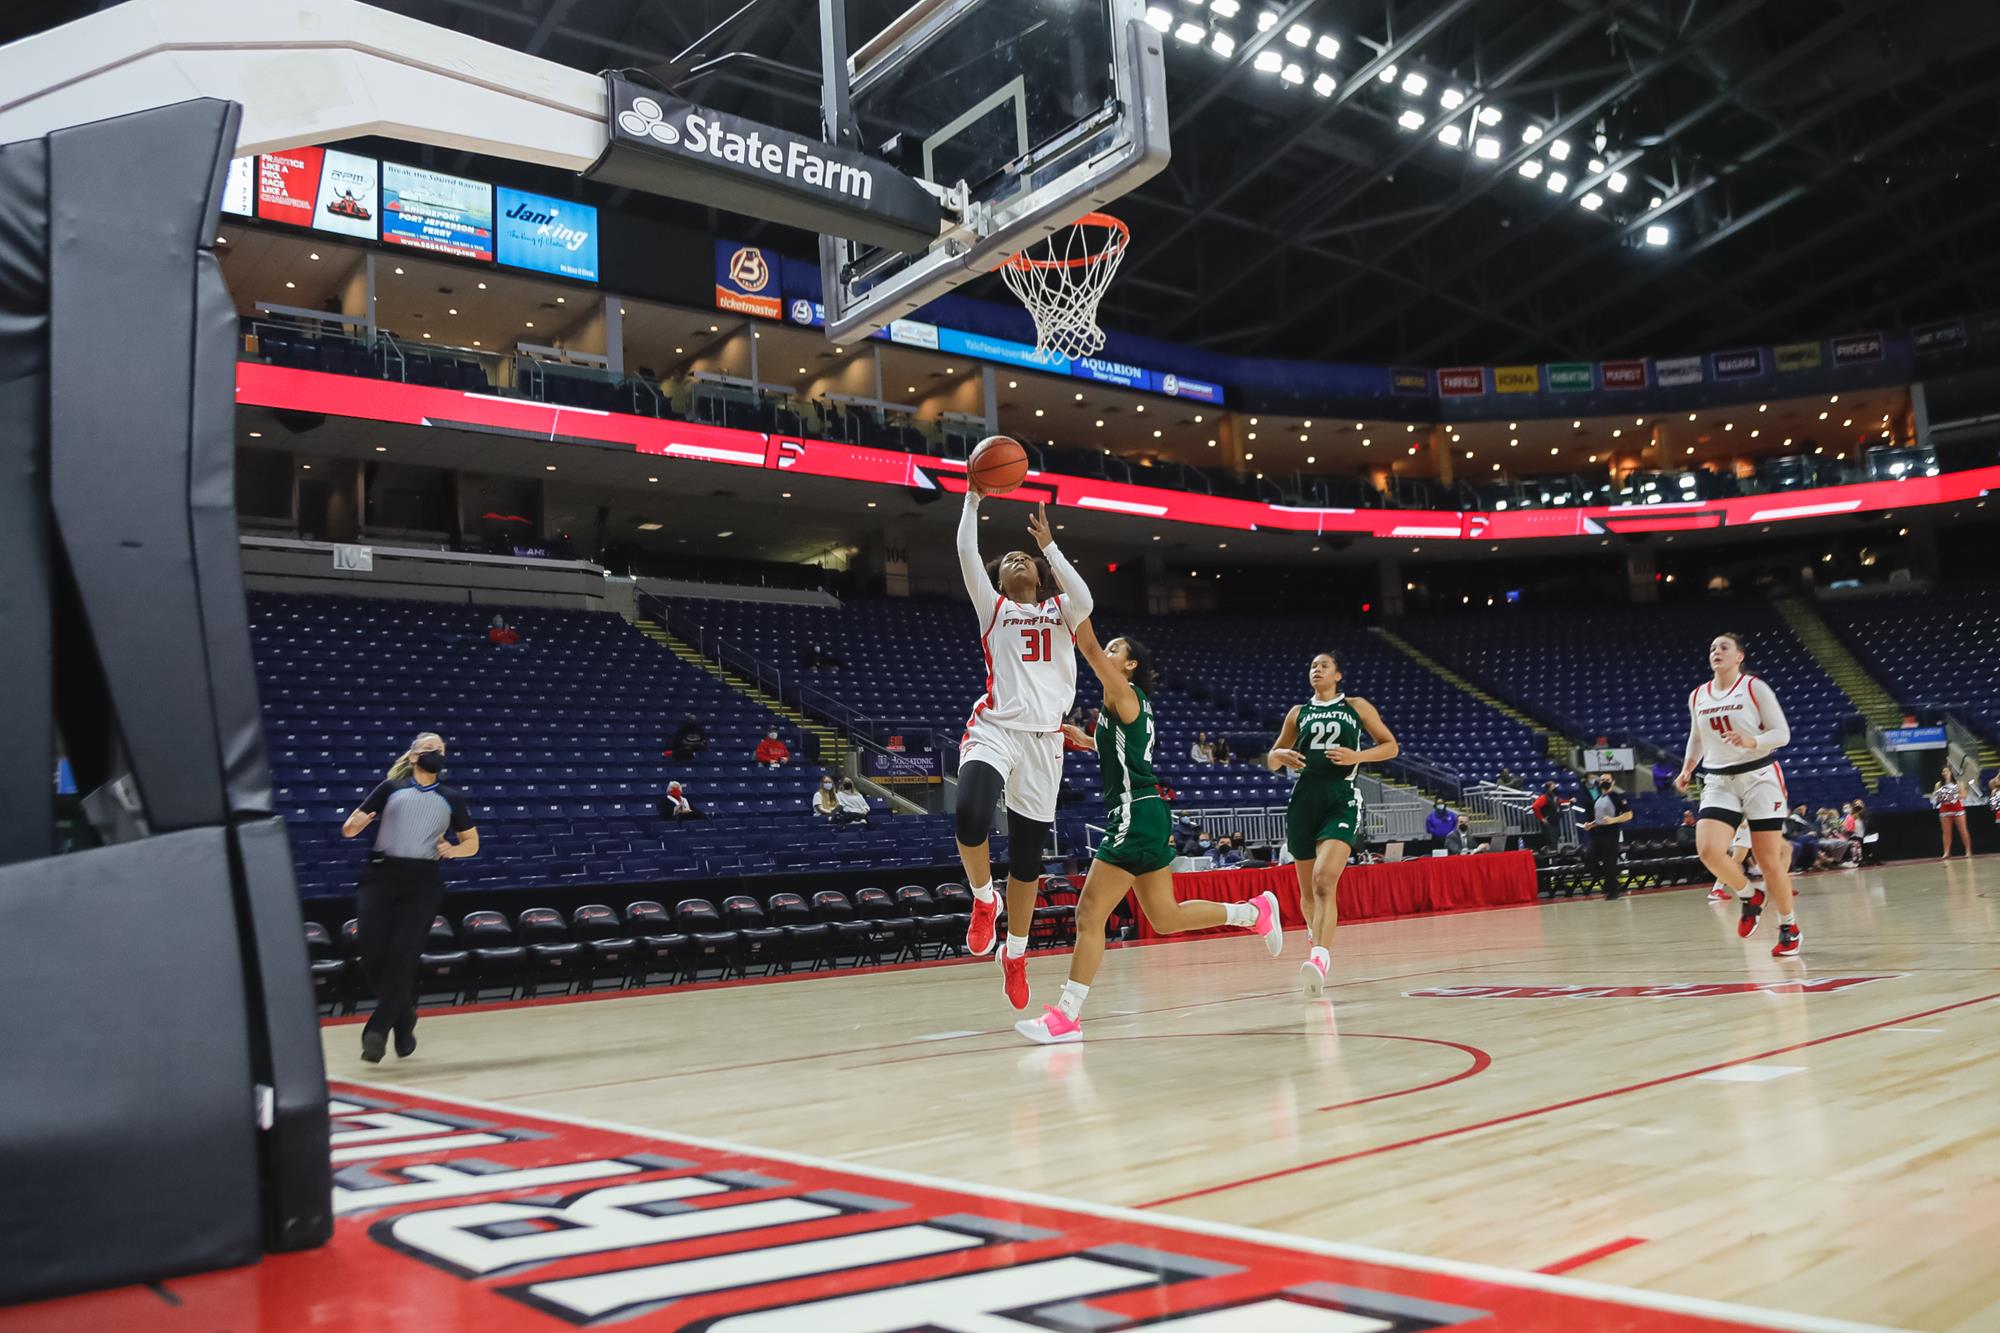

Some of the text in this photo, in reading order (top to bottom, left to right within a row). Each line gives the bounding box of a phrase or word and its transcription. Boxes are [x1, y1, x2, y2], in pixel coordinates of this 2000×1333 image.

[261, 153, 305, 170] PRACTICE
[261, 161, 281, 172] LIKE
[261, 177, 286, 189] RACE
[261, 185, 281, 196] LIKE
[404, 205, 461, 222] BRIDGEPORT
[506, 202, 555, 226] Jani
[398, 213, 475, 234] PORT JEFFERSON
[422, 226, 452, 238] FERRY
[720, 297, 778, 318] ticketmaster
[1081, 357, 1142, 379] AQUARION
[1003, 616, 1062, 627] FAIRFIELD
[1020, 628, 1051, 662] 31
[1698, 704, 1743, 716] FAIRFIELD
[1299, 711, 1357, 729] MANHATTAN
[1709, 715, 1733, 738] 41
[1310, 721, 1341, 750] 22
[1774, 802, 1782, 811] F
